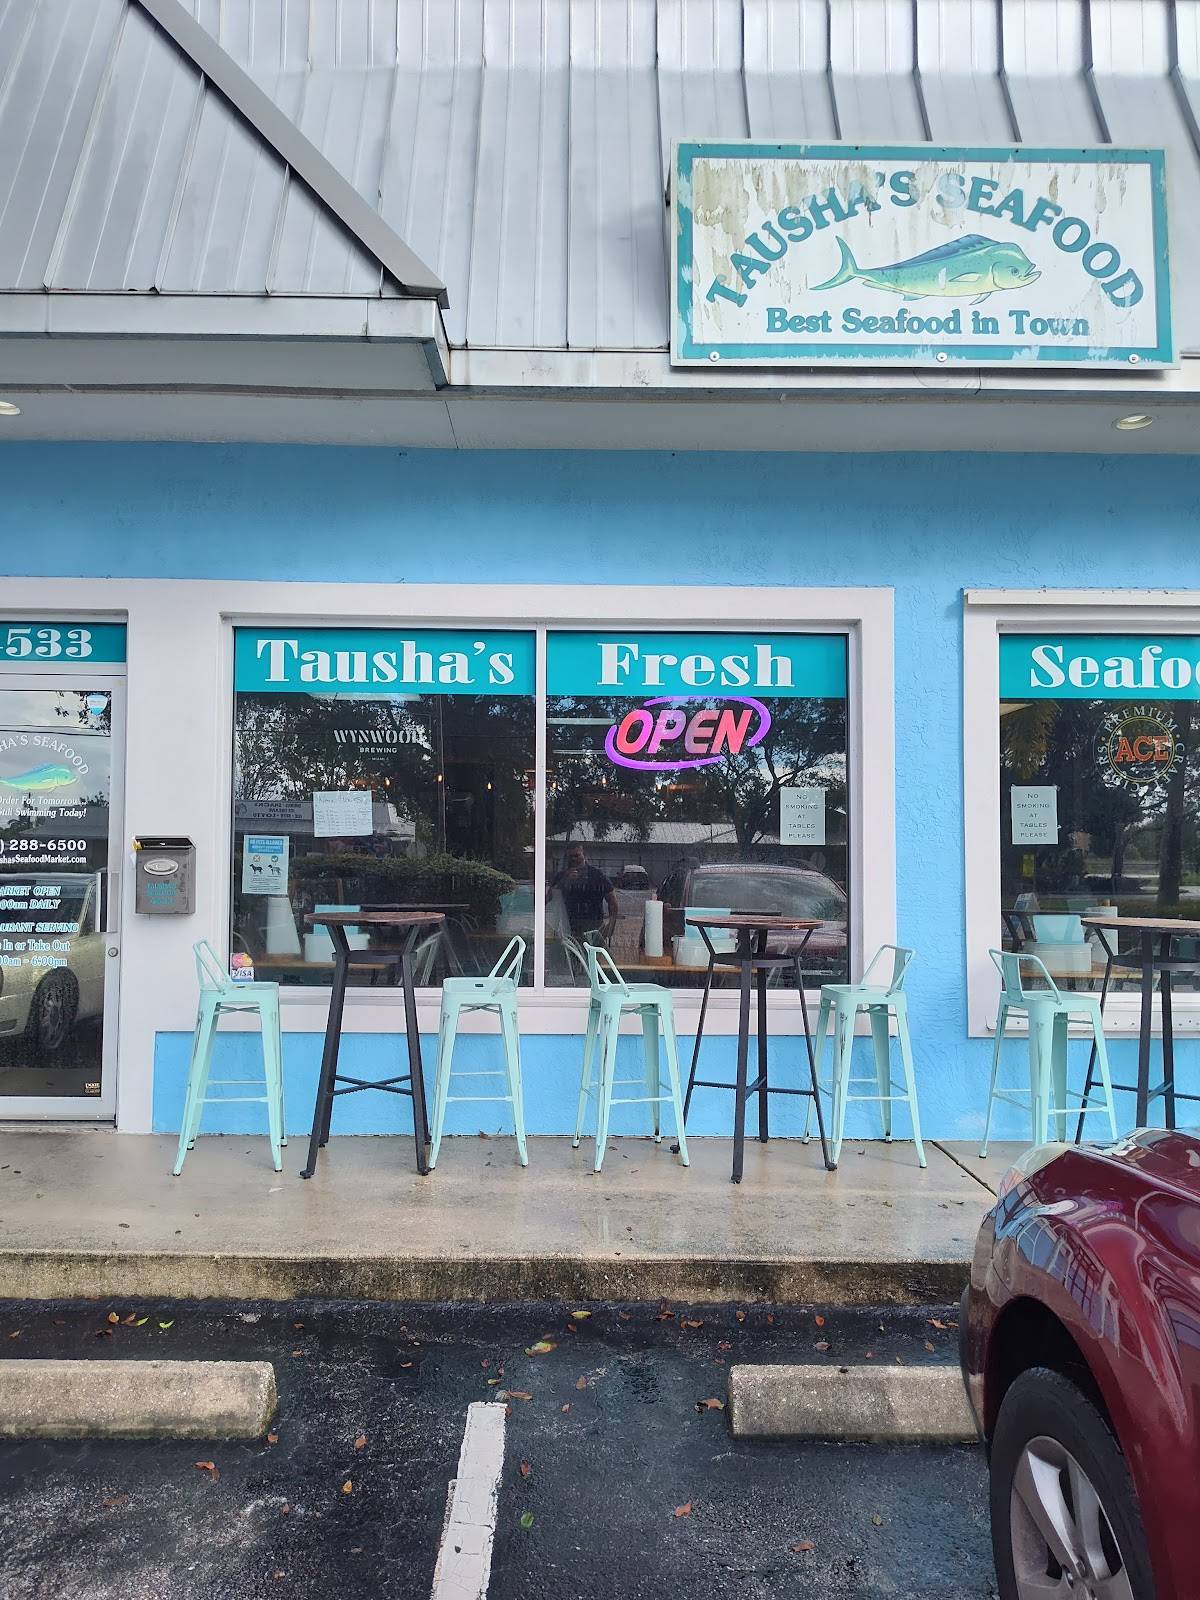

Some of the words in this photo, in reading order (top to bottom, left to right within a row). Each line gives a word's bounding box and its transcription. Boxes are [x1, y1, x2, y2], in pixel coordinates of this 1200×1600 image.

[706, 170, 916, 308] TAUSHA'S
[935, 172, 1144, 308] SEAFOOD
[766, 307, 832, 335] Best
[842, 307, 961, 336] Seafood
[971, 310, 999, 336] in
[1009, 310, 1089, 337] Town
[256, 638, 514, 685] Tausha's
[596, 642, 796, 688] Fresh
[1030, 643, 1200, 690] Seafo
[1104, 705, 1179, 733] PREMIUM
[615, 708, 753, 755] OPEN
[32, 735, 89, 775] SEAFOOD
[1114, 735, 1169, 763] ACE
[21, 795, 35, 805] For
[15, 807, 57, 819] Swimming
[59, 807, 87, 819] Today!
[9, 839, 87, 851] 288-6500
[32, 885, 62, 897] OPEN
[29, 898, 62, 910] DAILY
[35, 922, 80, 933] SERVING
[3, 938, 14, 951] In
[15, 942, 26, 951] or
[27, 938, 51, 951] Take
[52, 938, 71, 951] Out
[30, 955, 68, 969] 6:00pm
[232, 969, 252, 977] VISA
